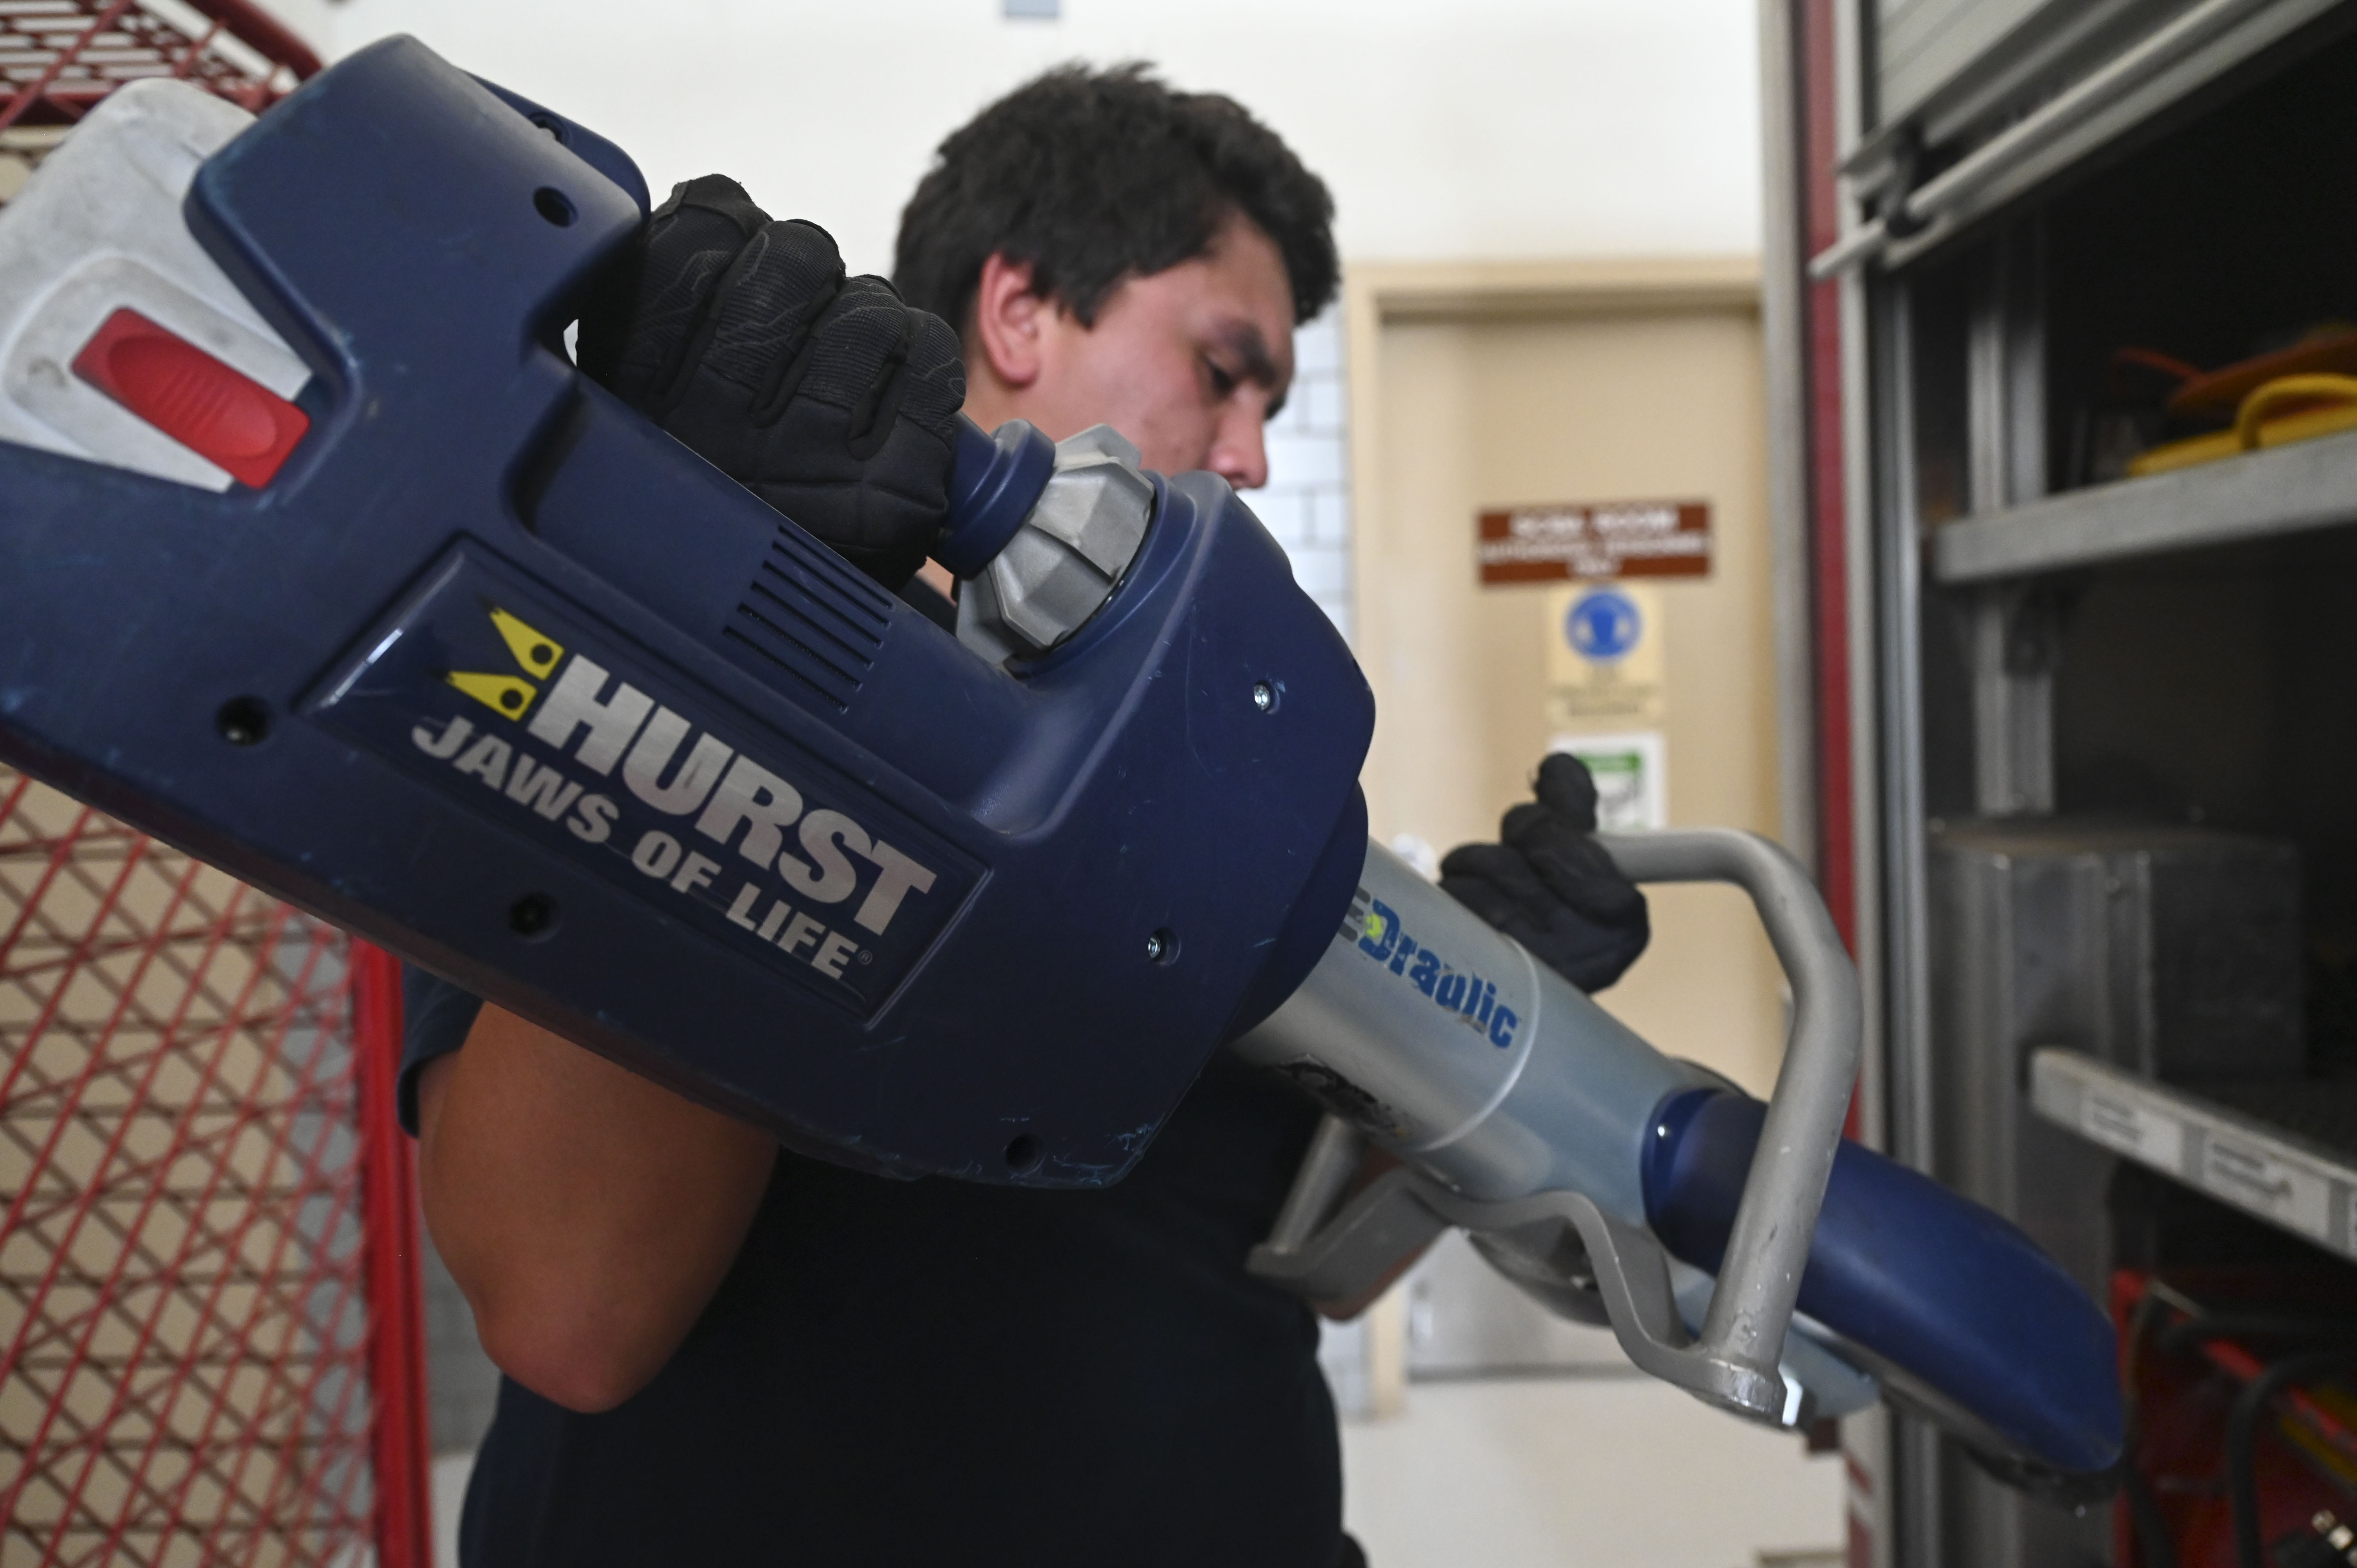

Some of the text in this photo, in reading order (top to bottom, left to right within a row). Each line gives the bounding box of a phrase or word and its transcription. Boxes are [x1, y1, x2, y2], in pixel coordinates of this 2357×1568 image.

[411, 714, 620, 843] JAWS
[631, 830, 722, 893] OF
[527, 653, 937, 936] HURST
